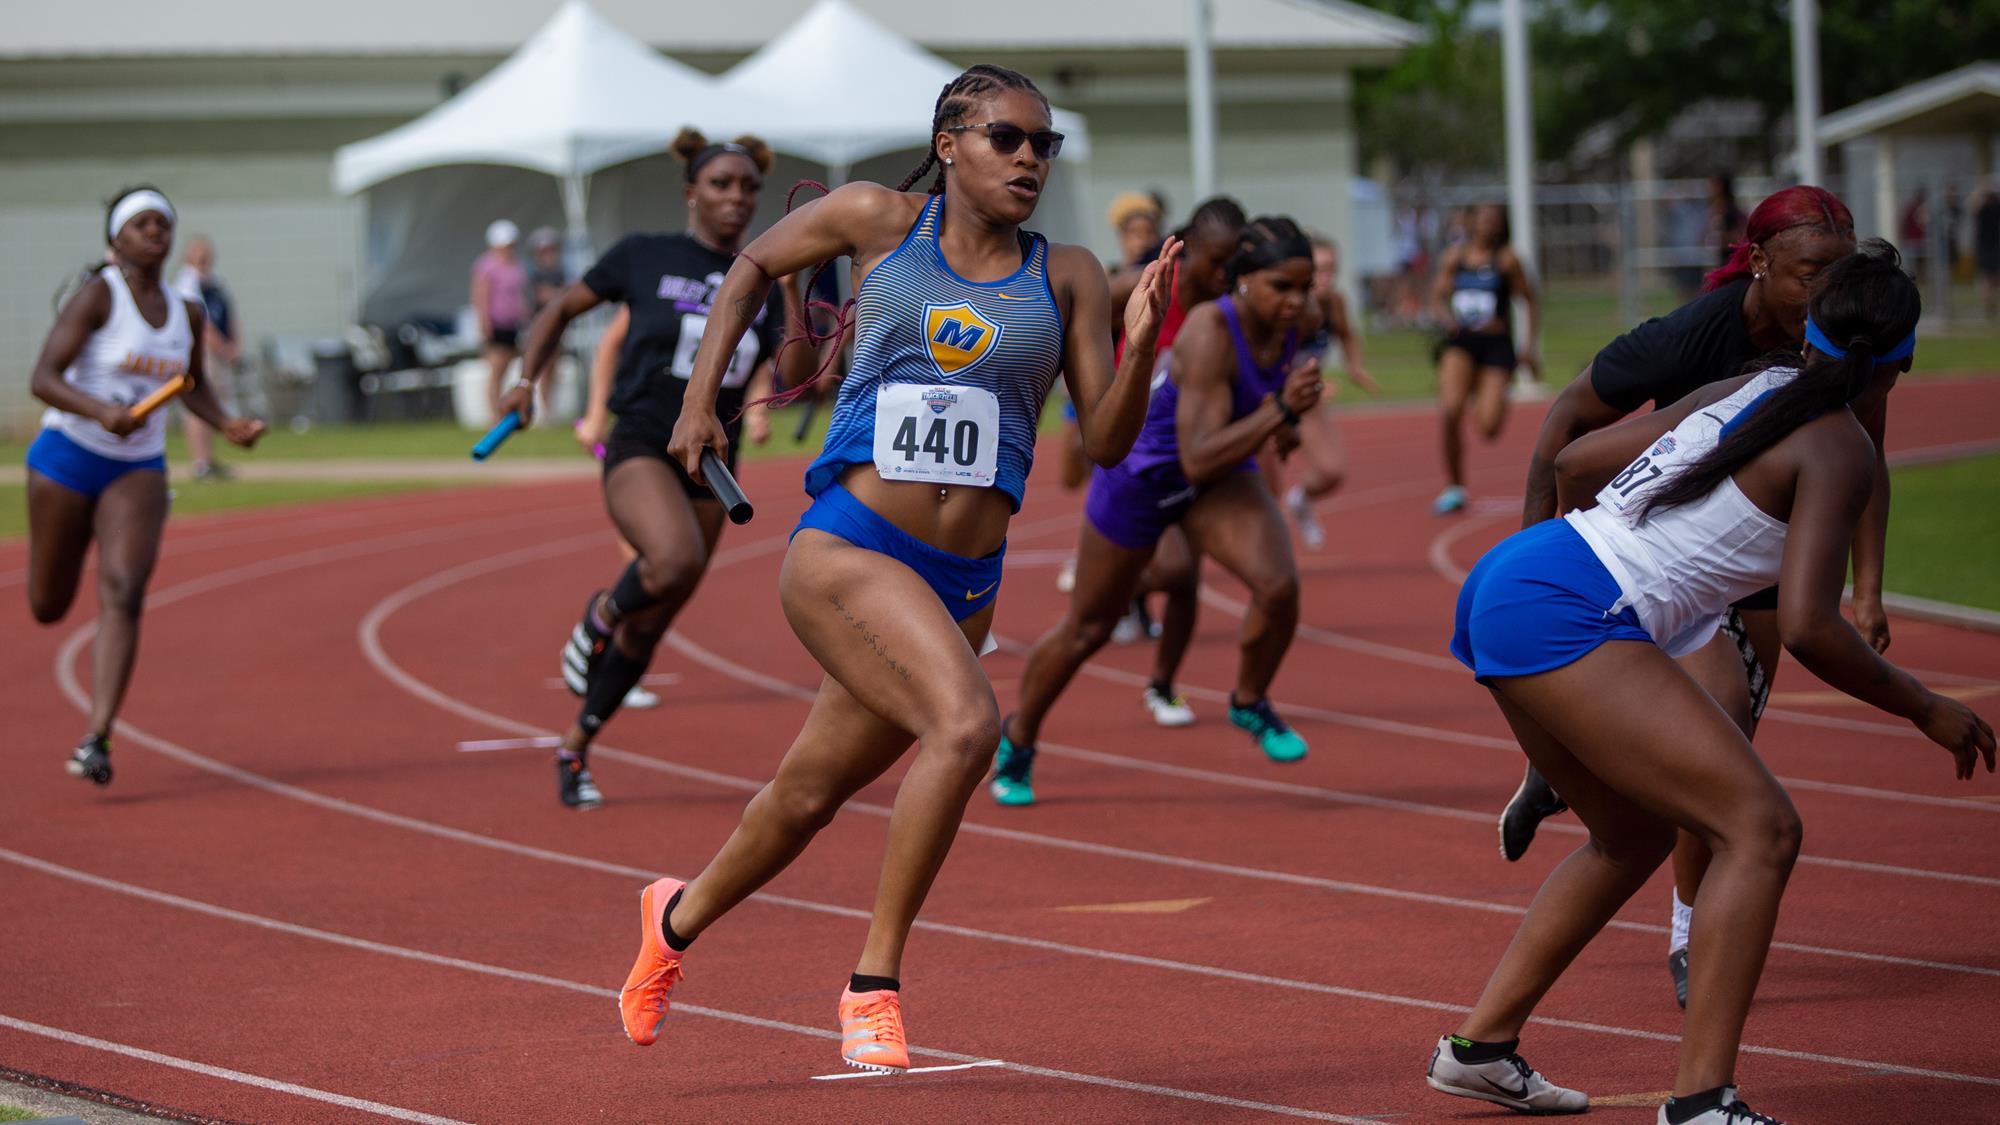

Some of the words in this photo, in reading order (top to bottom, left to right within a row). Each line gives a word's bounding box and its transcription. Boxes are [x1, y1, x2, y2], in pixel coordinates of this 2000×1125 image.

[932, 317, 985, 352] M
[893, 416, 979, 466] 440
[1610, 456, 1663, 498] 87
